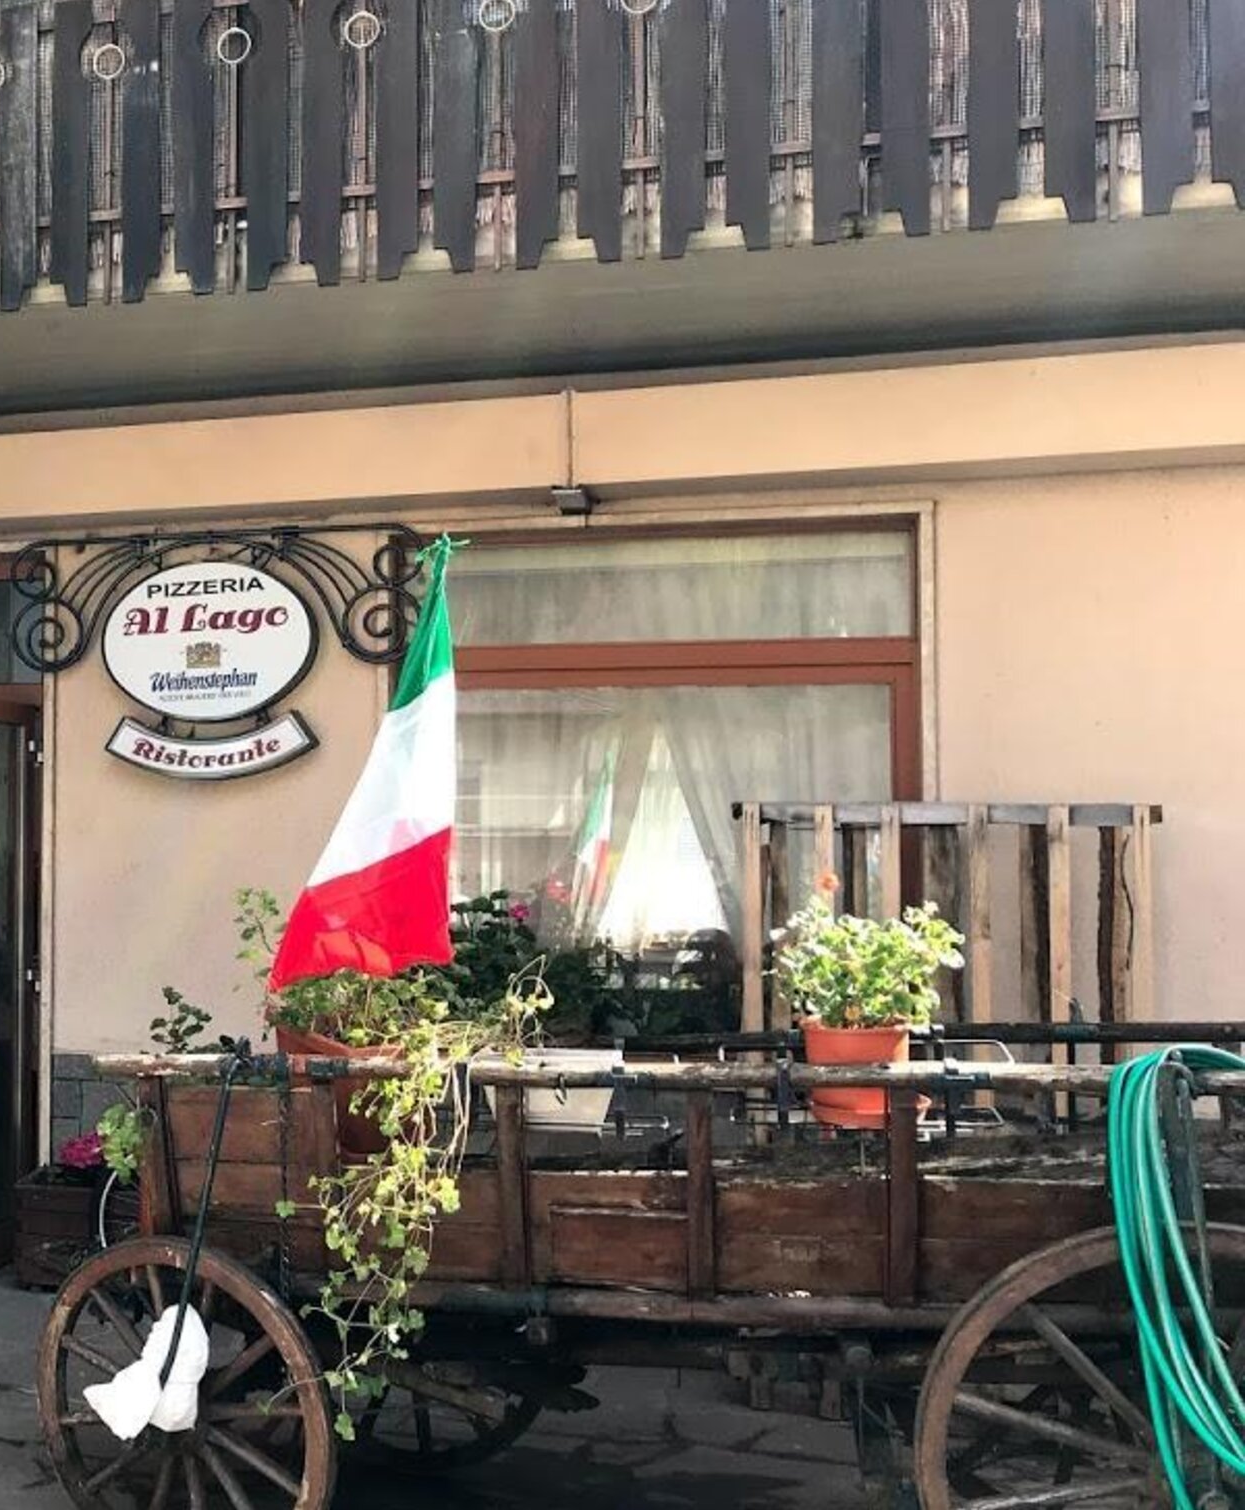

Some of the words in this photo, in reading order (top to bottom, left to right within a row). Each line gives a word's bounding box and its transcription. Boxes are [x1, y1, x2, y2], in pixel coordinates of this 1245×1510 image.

[146, 577, 264, 599] PIZZERIA
[123, 606, 169, 636] Al
[180, 603, 289, 633] Lago
[150, 668, 258, 692] Weihenstephan
[132, 737, 281, 768] Ristorante
